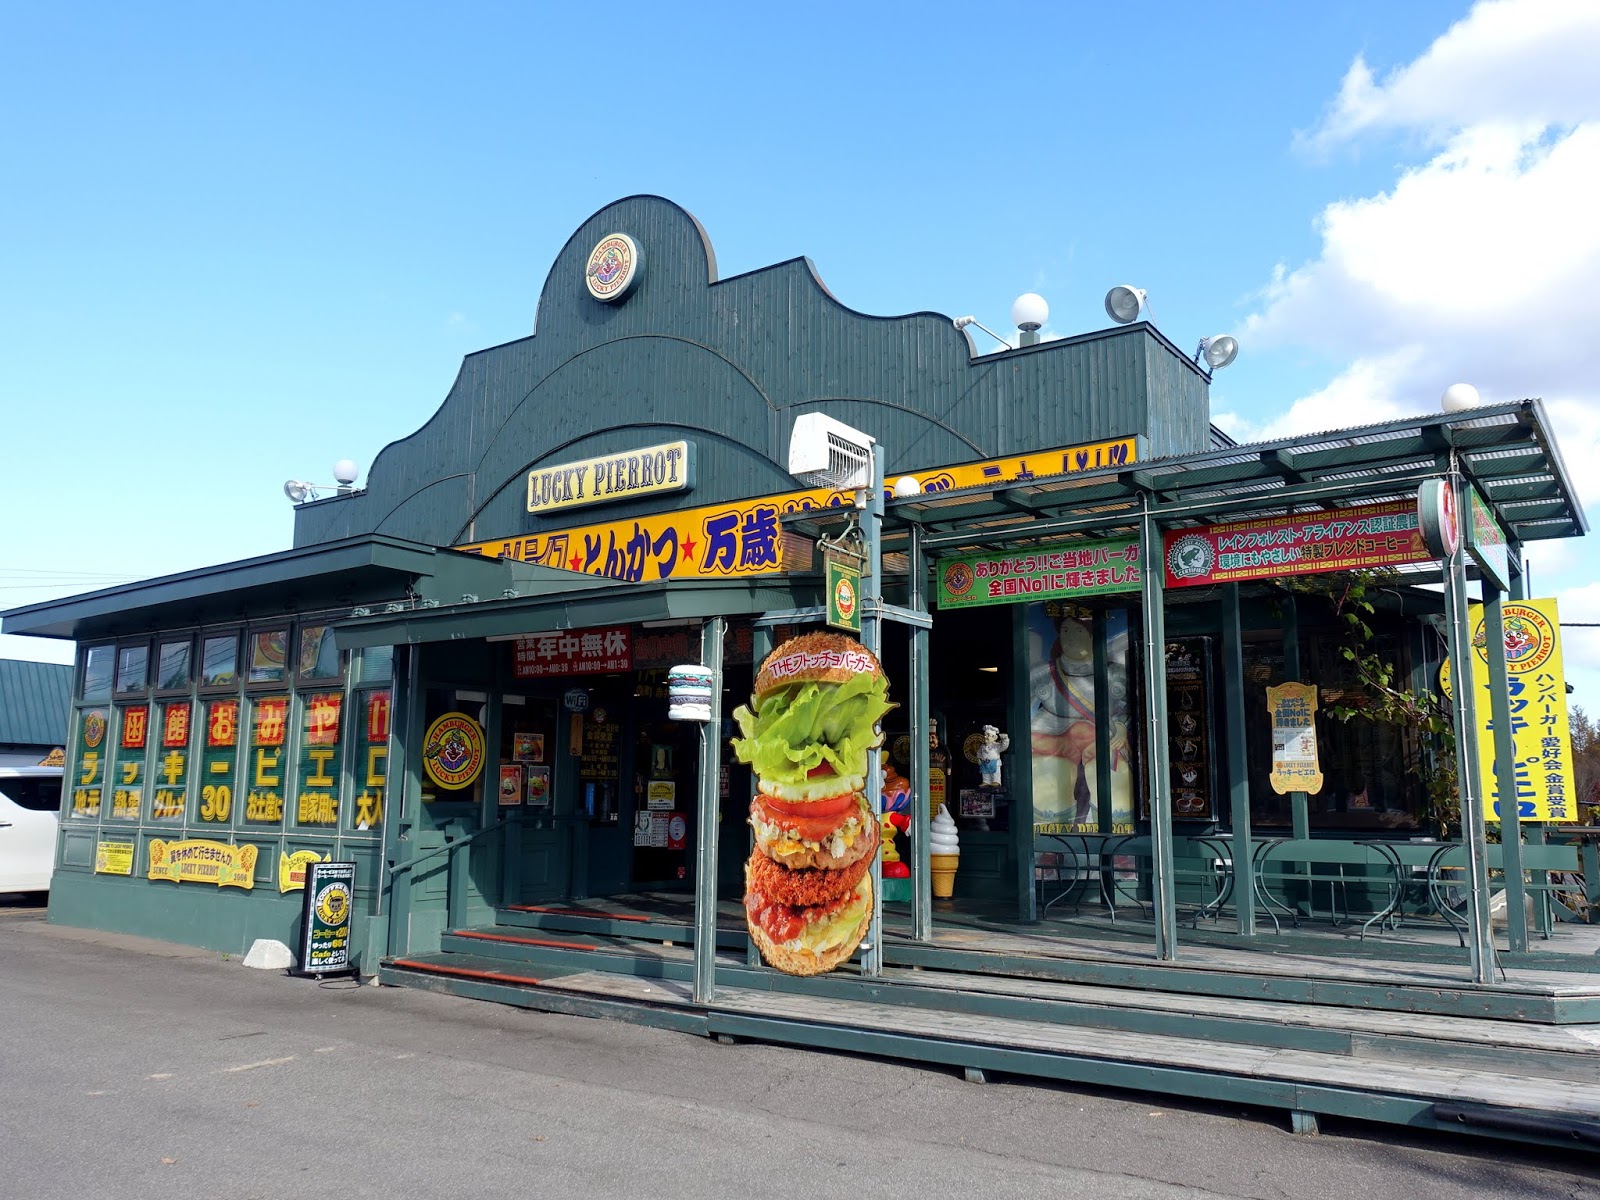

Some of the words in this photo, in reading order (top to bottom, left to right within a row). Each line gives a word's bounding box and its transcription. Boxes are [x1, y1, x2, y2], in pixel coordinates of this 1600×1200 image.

[594, 240, 628, 261] HAMBURGER
[592, 278, 608, 291] LUCKY
[610, 260, 629, 289] PIERROT
[530, 466, 588, 506] LUCKY
[593, 447, 681, 496] PIERROT
[537, 631, 627, 660] 年中無休
[1520, 635, 1551, 671] PIERROT
[433, 720, 477, 741] HAMBURGER
[432, 762, 456, 782] LUCKY
[458, 749, 480, 780] PIERROT
[201, 785, 231, 821] 30
[180, 863, 196, 875] LUCKY
[197, 864, 220, 877] PIERROT
